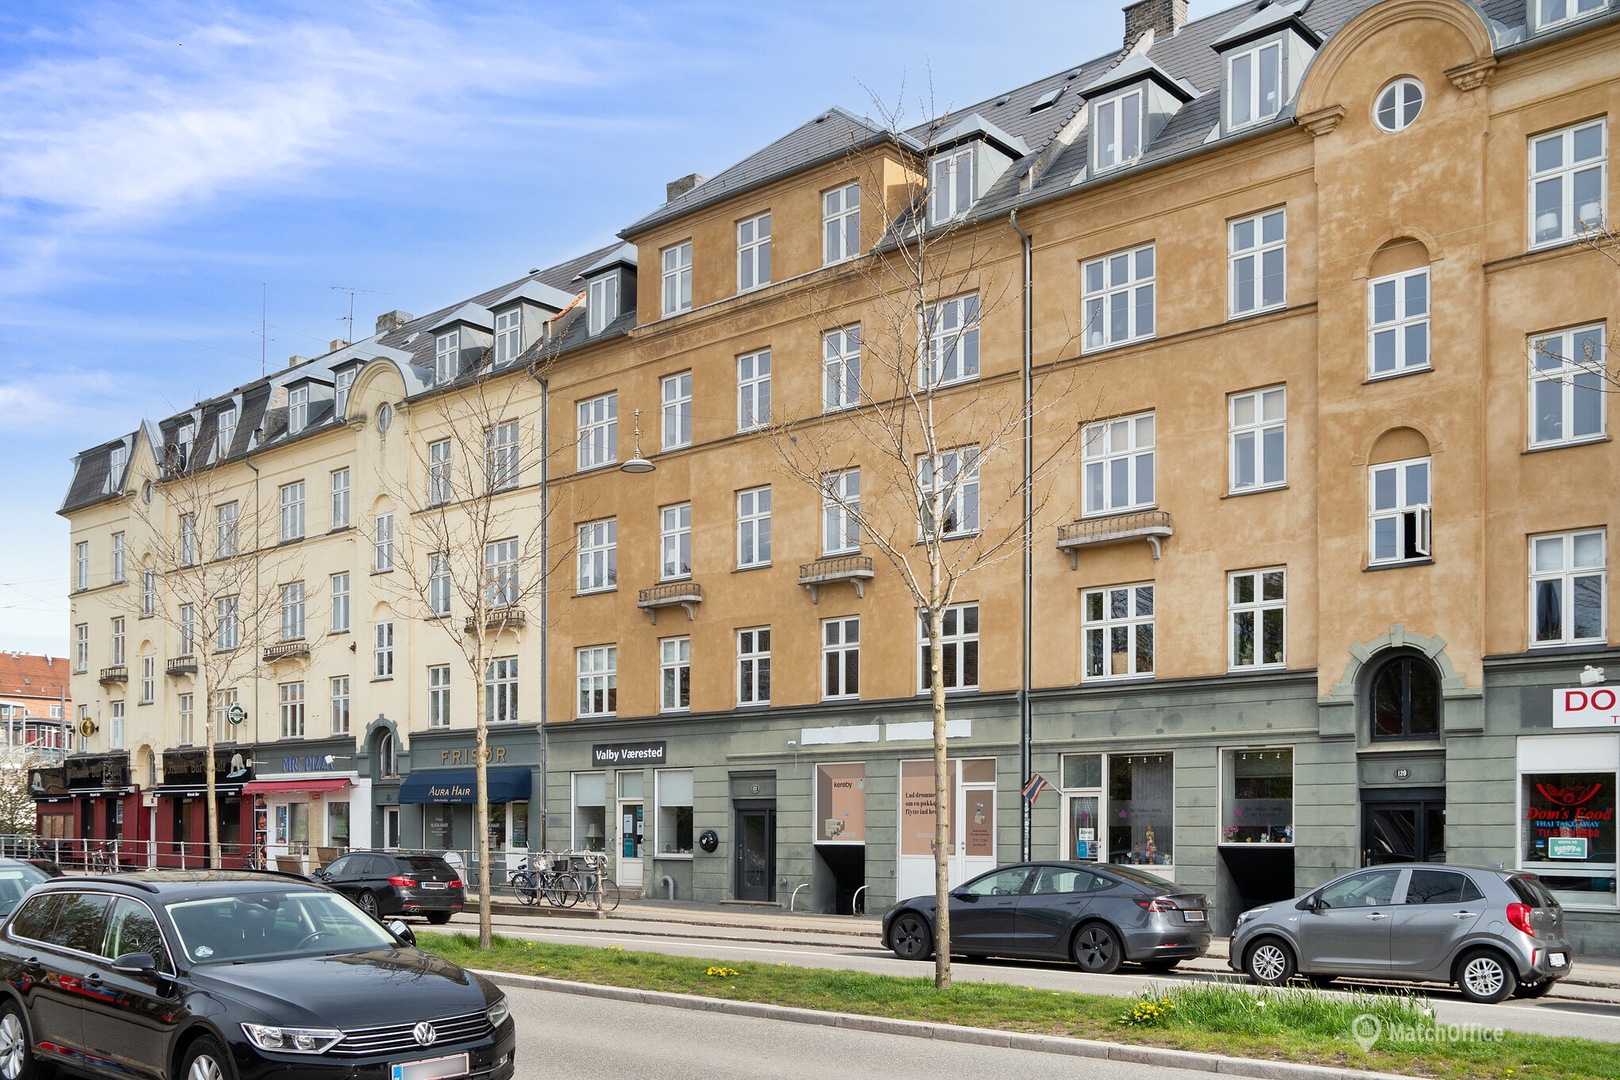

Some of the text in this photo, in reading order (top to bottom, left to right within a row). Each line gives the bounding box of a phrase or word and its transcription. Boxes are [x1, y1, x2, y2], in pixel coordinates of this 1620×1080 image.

[595, 746, 663, 762] Valby Værested
[282, 757, 301, 773] MR.
[833, 781, 853, 789] kereby
[1527, 807, 1613, 820] Dom's Food
[1535, 820, 1554, 828] THAI
